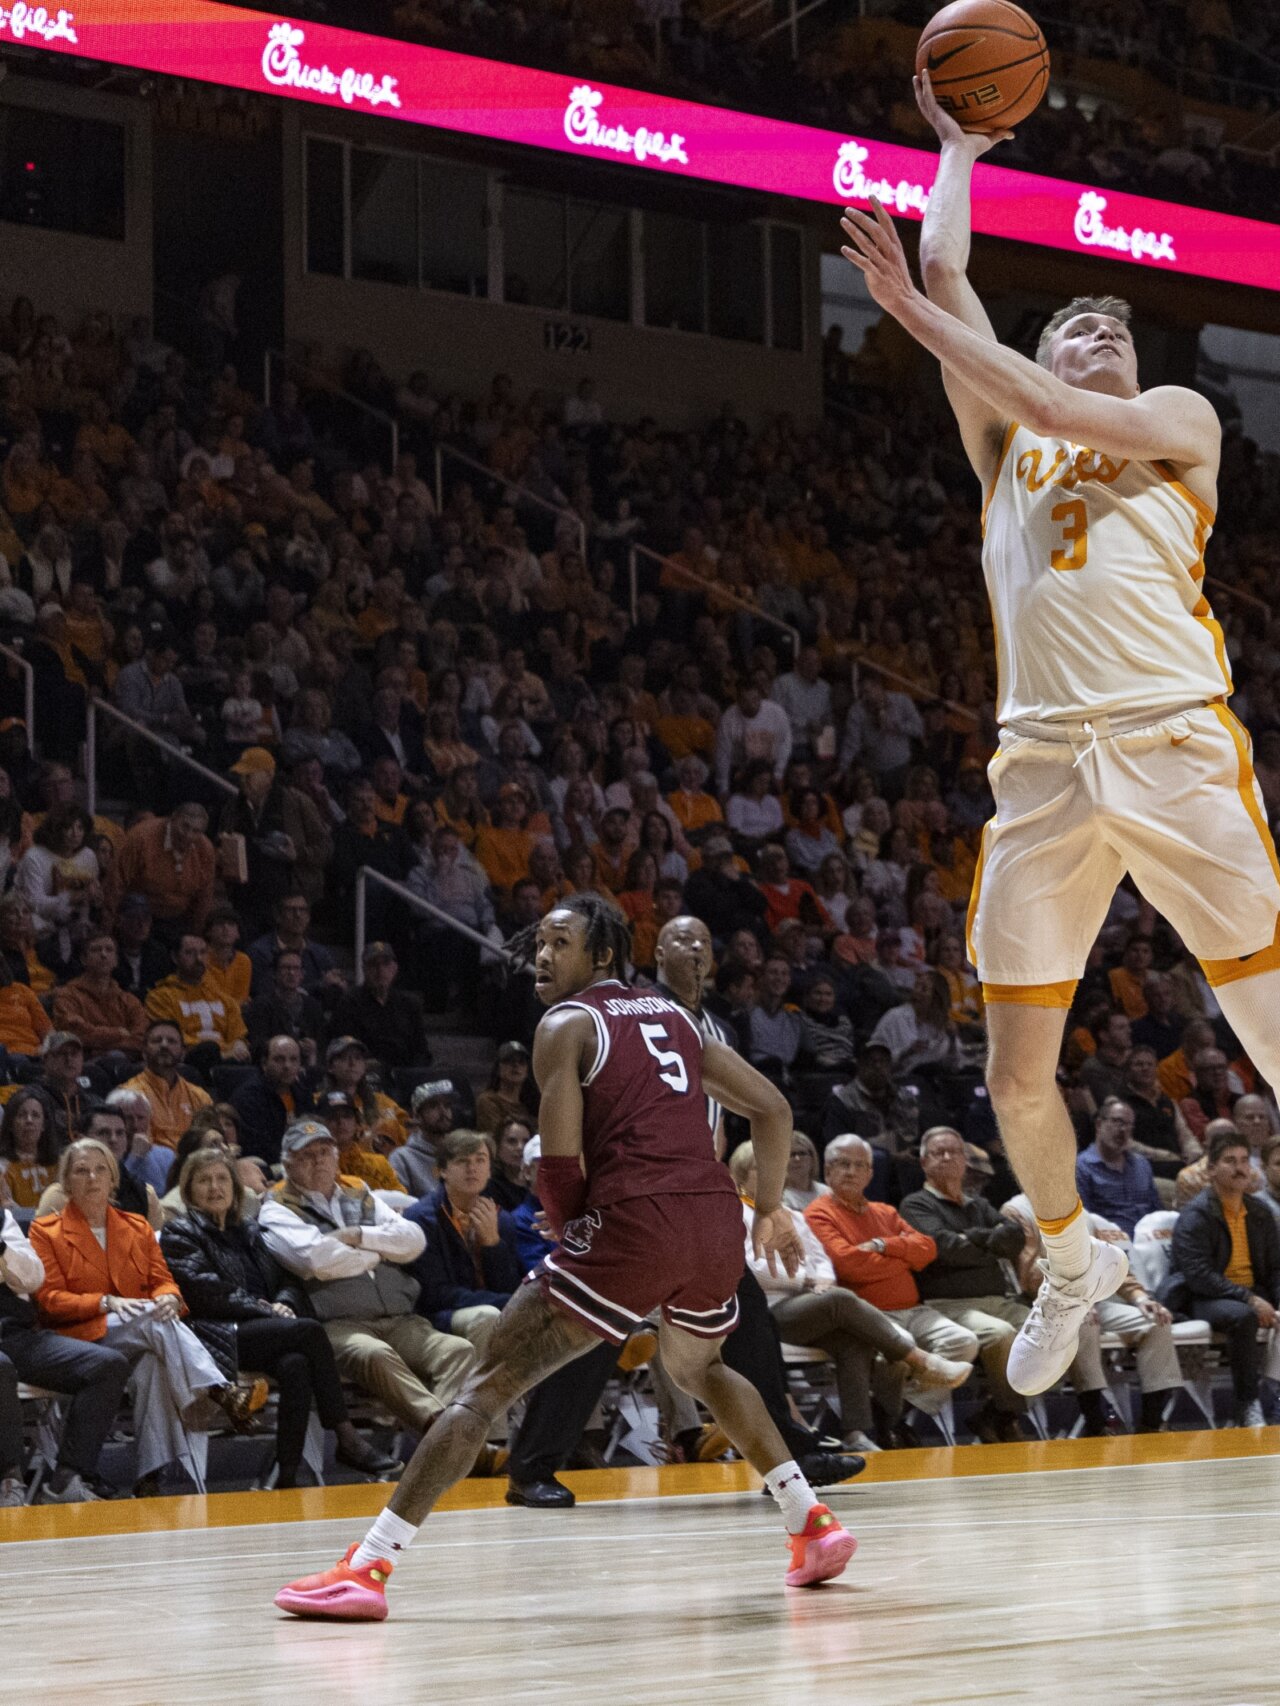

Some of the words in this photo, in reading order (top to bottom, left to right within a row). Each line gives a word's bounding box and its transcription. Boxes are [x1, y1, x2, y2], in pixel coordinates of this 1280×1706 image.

[262, 22, 401, 108] Chick-fil-A
[564, 85, 689, 164] Chick-fil-A
[833, 140, 930, 213] Chick-fil-
[1074, 191, 1177, 261] Chick-fil-A
[546, 324, 591, 353] 122
[1051, 499, 1088, 571] 3
[179, 1000, 225, 1041] T
[603, 996, 675, 1016] JOHNSON
[638, 1022, 690, 1096] 5
